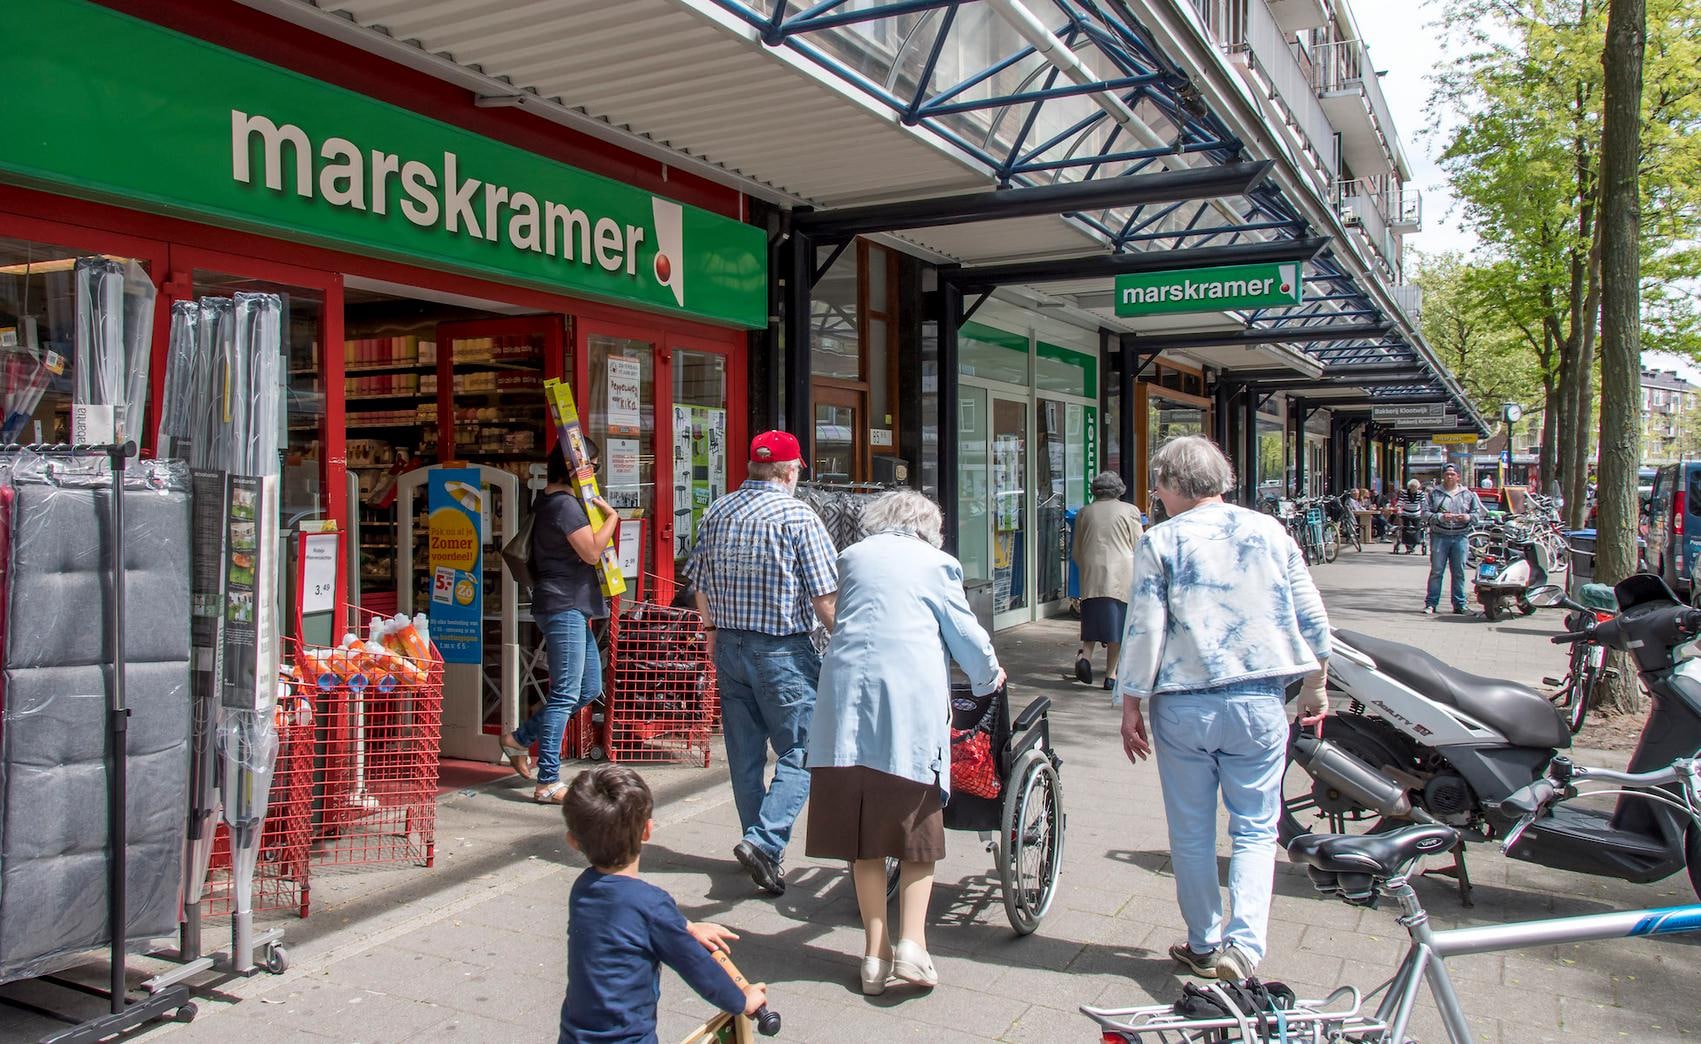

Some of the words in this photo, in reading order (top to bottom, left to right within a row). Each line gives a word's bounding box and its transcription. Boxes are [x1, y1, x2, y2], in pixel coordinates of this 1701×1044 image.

[231, 108, 645, 275] marskramer
[1123, 277, 1274, 304] marskramer
[1374, 407, 1399, 415] Bakkerij
[431, 536, 472, 549] Zomer
[431, 551, 472, 561] voordeel!
